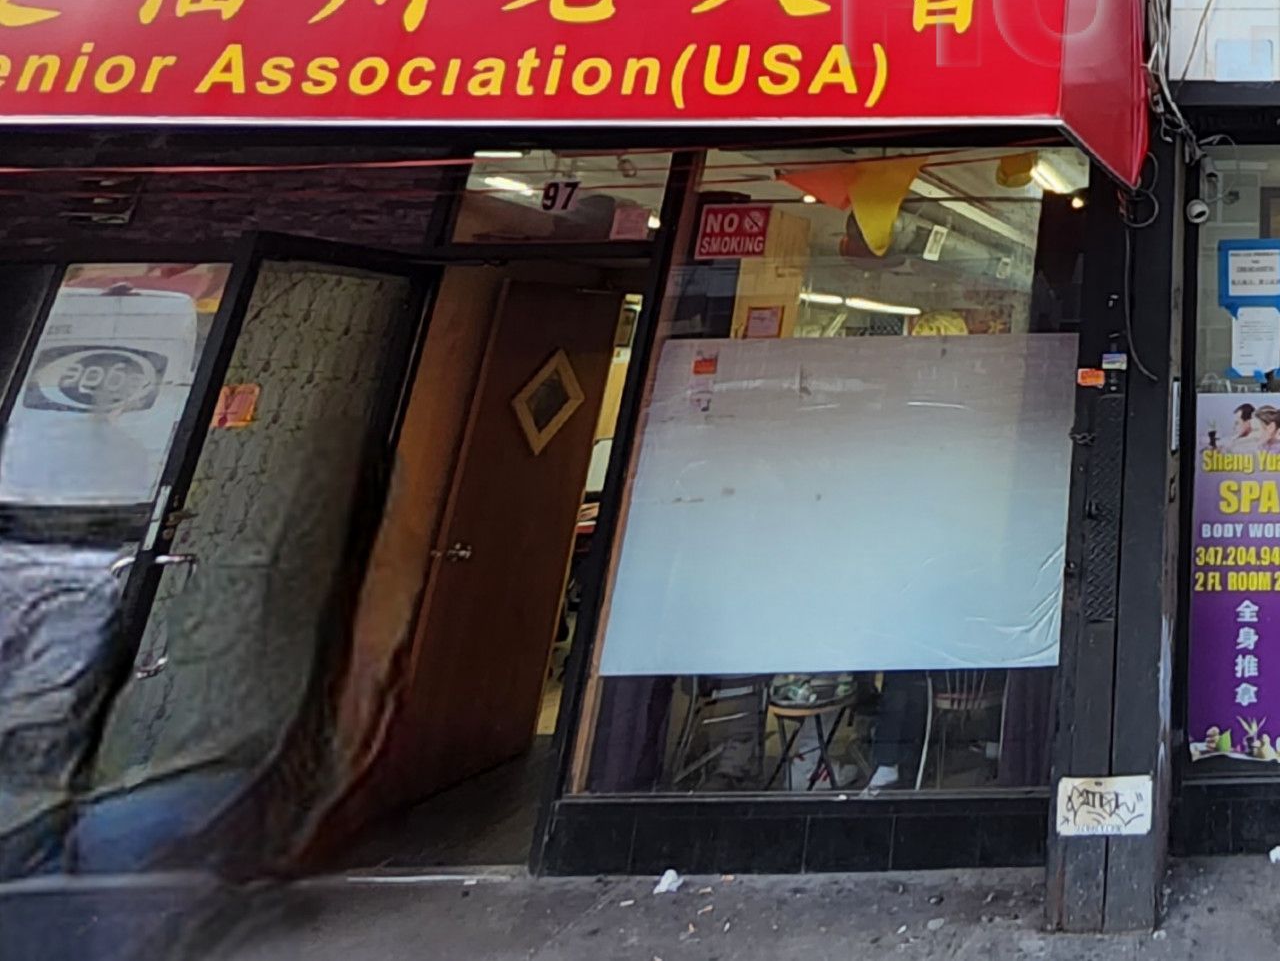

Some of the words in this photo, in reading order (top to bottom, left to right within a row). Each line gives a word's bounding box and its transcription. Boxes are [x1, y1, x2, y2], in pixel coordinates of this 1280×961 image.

[541, 181, 580, 211] 97
[705, 212, 739, 232] NO
[700, 237, 765, 255] SMOKING
[1202, 450, 1254, 475] Sheng
[1201, 522, 1244, 539] BODY
[1194, 571, 1205, 592] 2
[1207, 571, 1223, 592] FL
[1228, 571, 1273, 592] ROOM
